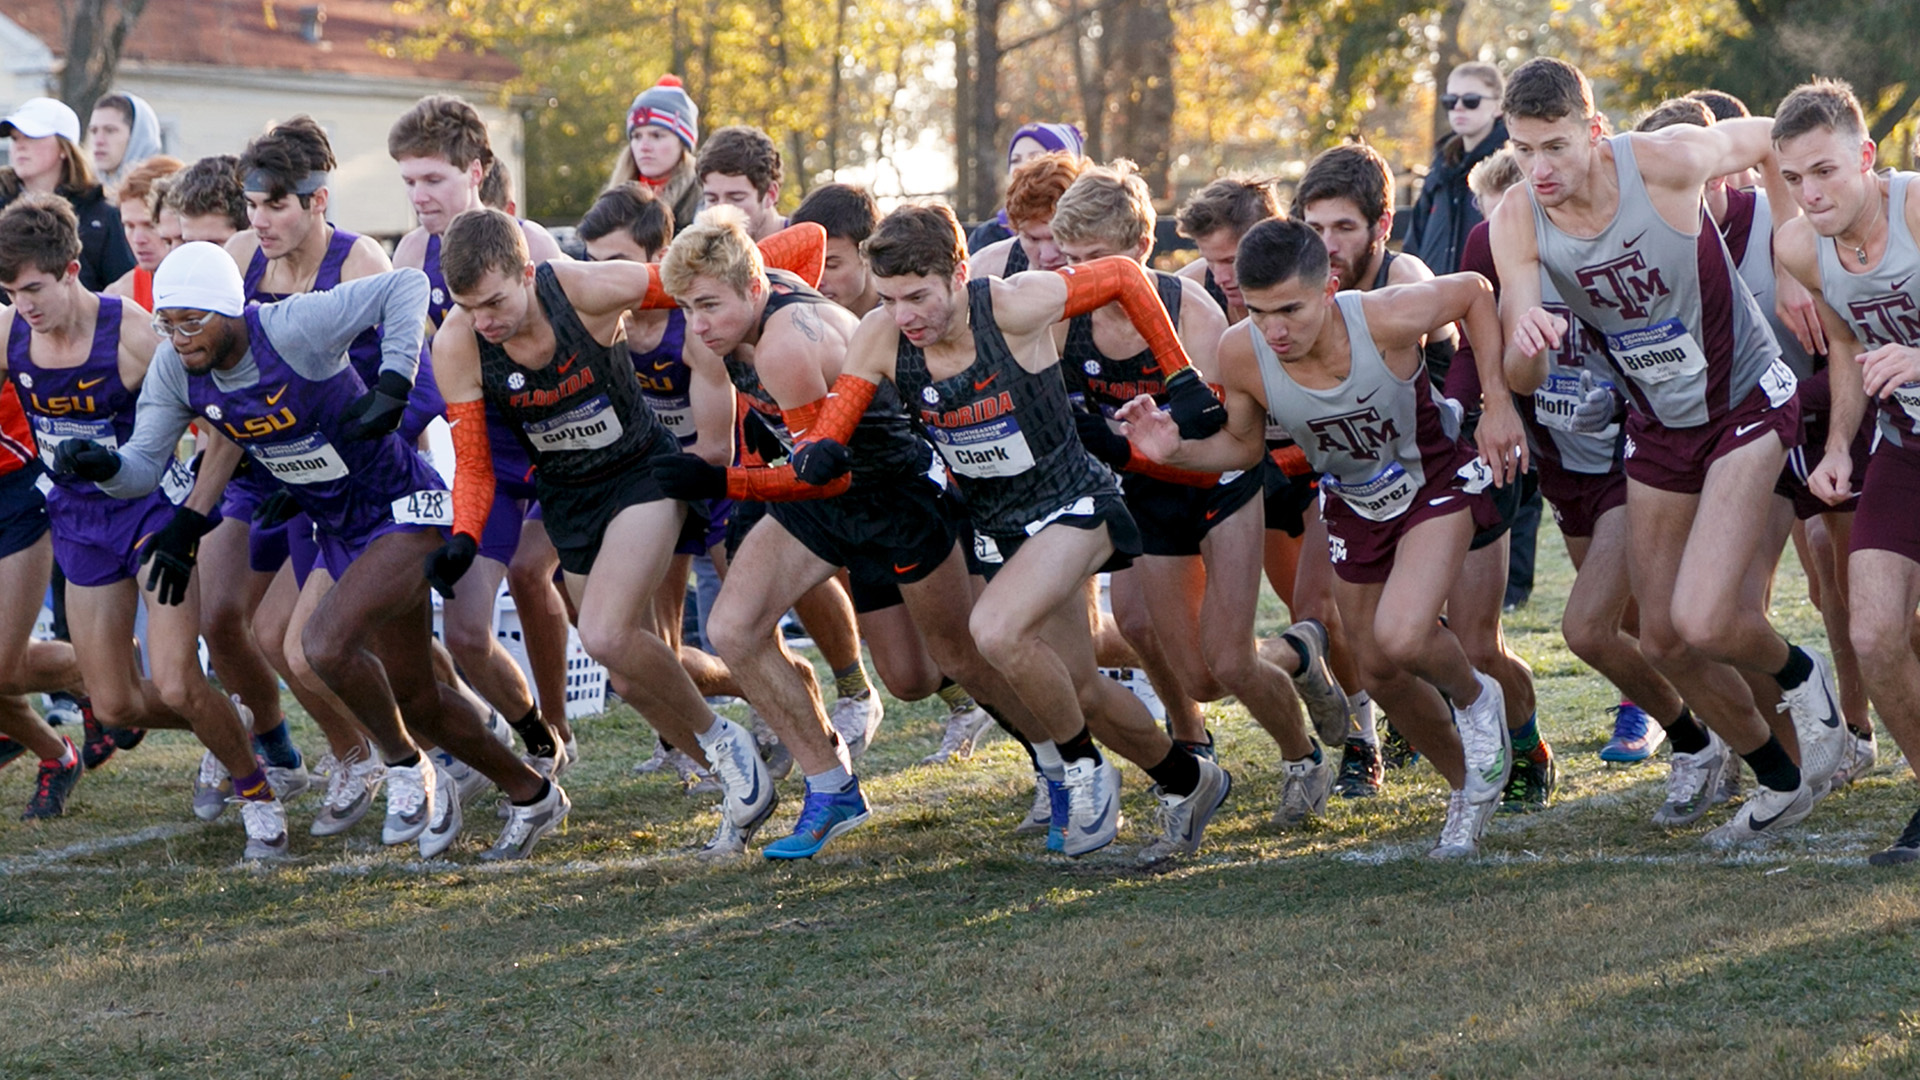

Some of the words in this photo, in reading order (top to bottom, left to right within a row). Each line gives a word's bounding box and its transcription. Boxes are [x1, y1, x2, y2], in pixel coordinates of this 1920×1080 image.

[1084, 360, 1100, 375] SEC
[1623, 346, 1686, 371] Bishop
[507, 372, 525, 390] SEC
[510, 366, 595, 407] FLORIDA
[31, 392, 95, 415] LSU
[921, 390, 1015, 428] FLORIDA
[224, 406, 297, 438] LSU
[543, 419, 607, 444] Guyton
[265, 456, 328, 474] Coston
[955, 445, 1010, 465] Clark
[407, 491, 443, 519] 428
